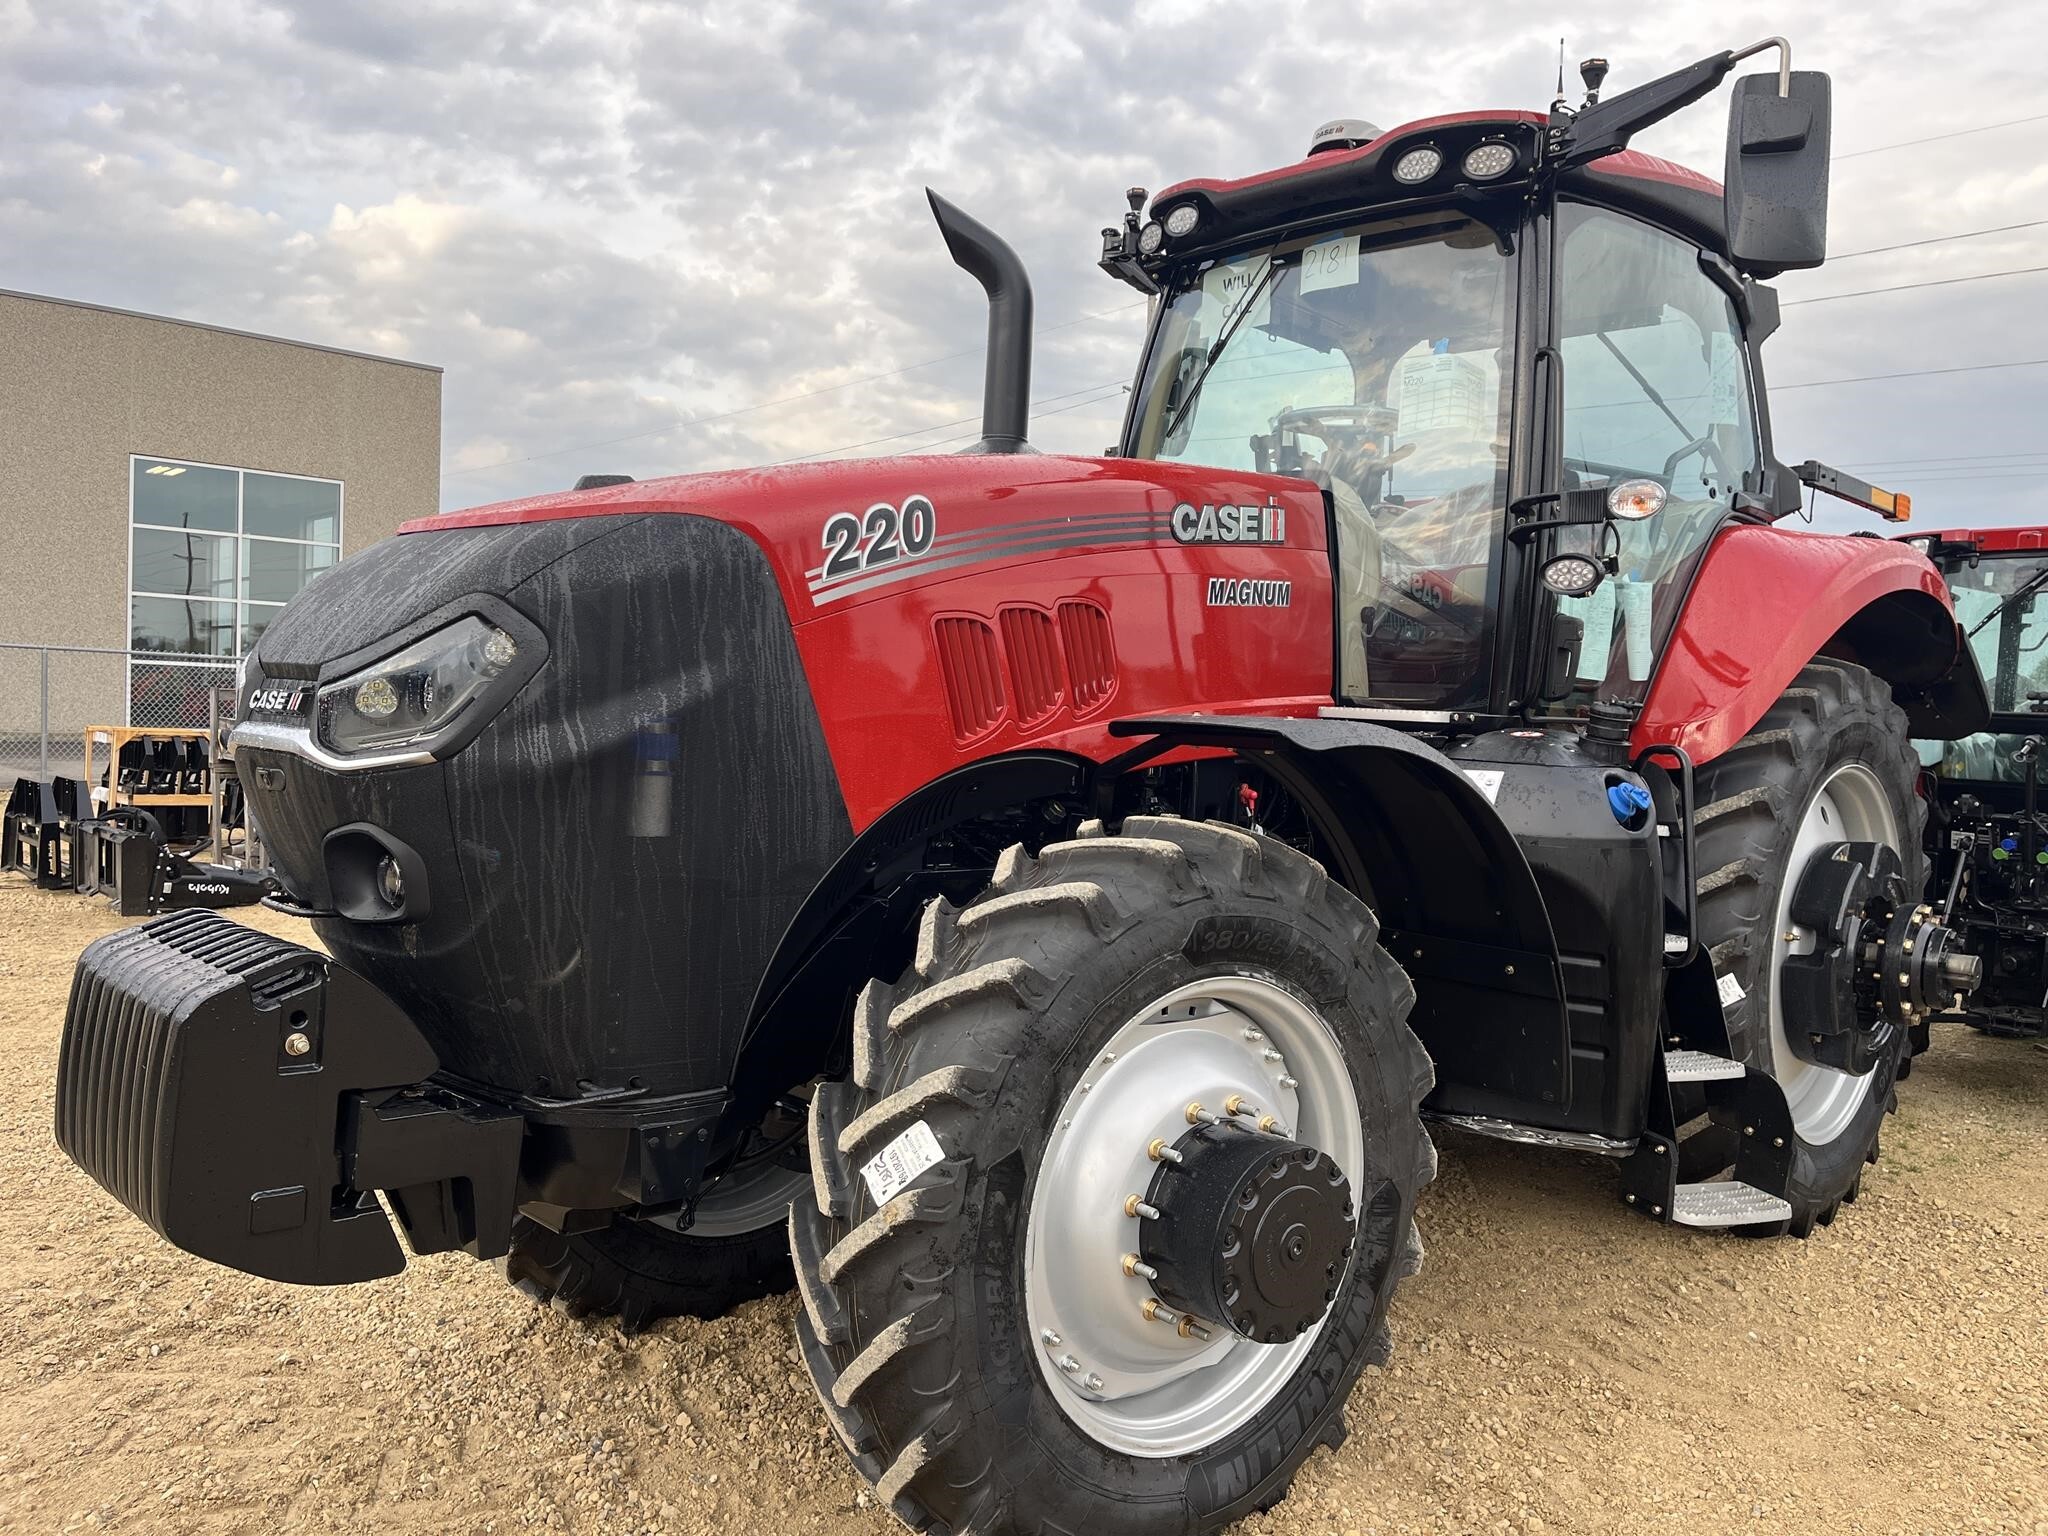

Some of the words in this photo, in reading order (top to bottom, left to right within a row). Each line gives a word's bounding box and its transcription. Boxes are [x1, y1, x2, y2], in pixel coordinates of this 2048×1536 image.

[1315, 128, 1335, 139] CASE
[1304, 242, 1350, 279] 2181
[1222, 272, 1252, 292] WILL
[1171, 502, 1260, 545] CASE
[821, 494, 936, 583] 220
[1206, 577, 1291, 608] MAGNUM
[248, 688, 288, 710] CASE
[188, 883, 231, 896] Kubota
